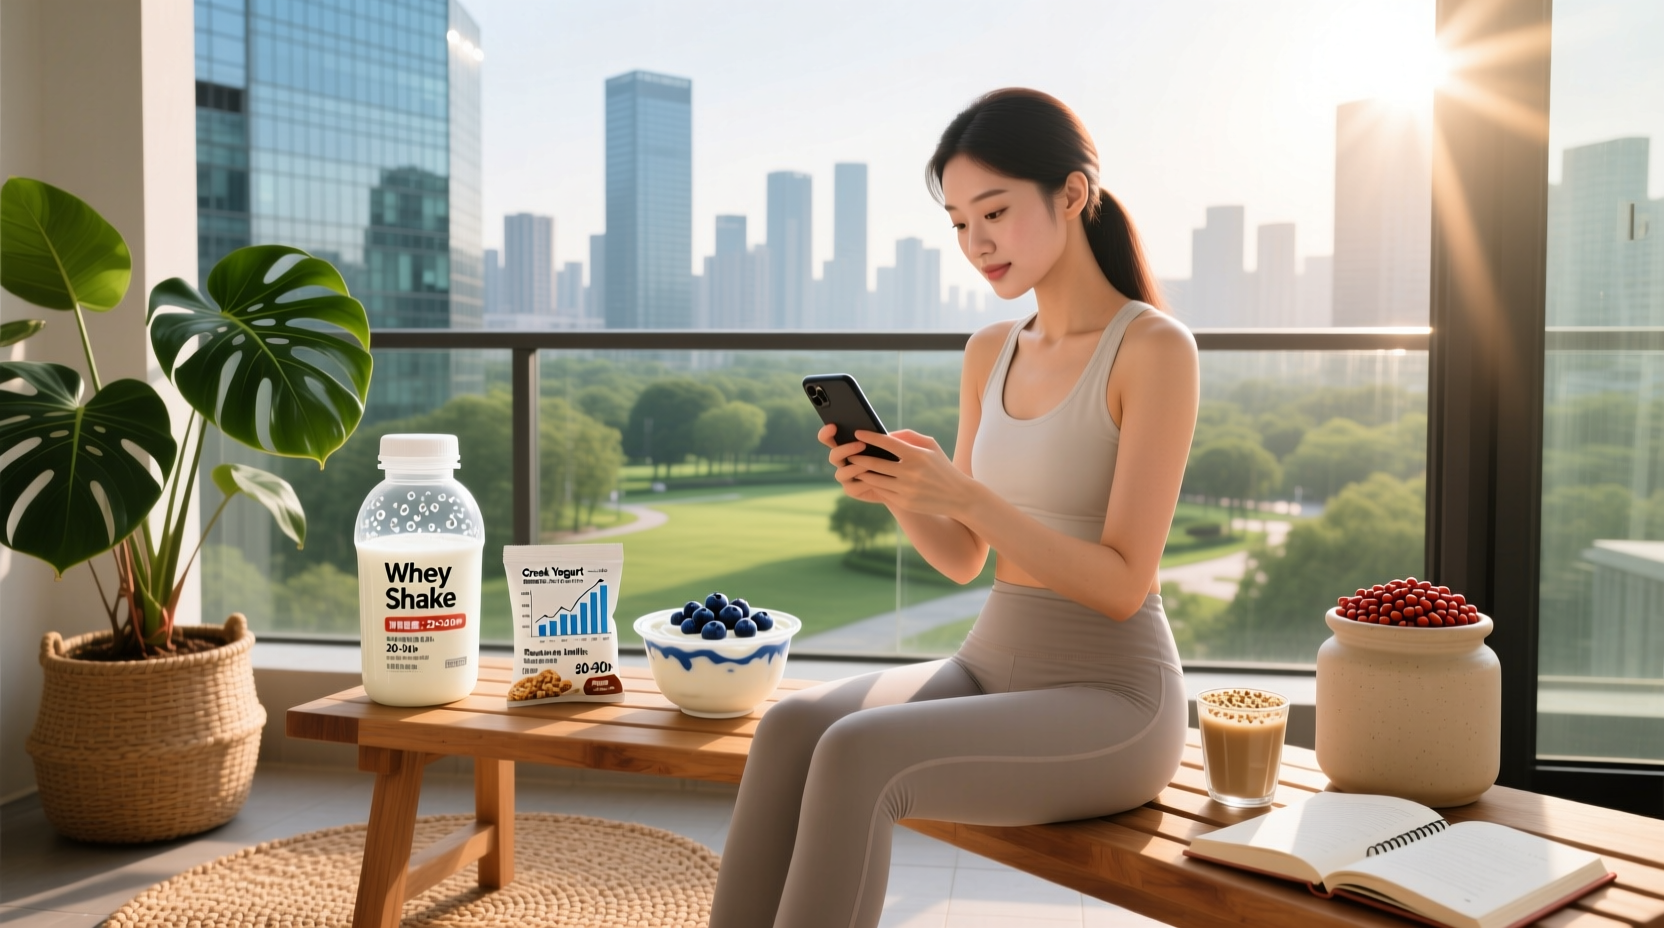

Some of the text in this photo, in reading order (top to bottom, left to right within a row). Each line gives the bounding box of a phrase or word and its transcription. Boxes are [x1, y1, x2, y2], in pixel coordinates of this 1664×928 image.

[384, 562, 453, 588] Whey
[551, 566, 584, 579] Yogurt
[385, 587, 456, 610] Shake
